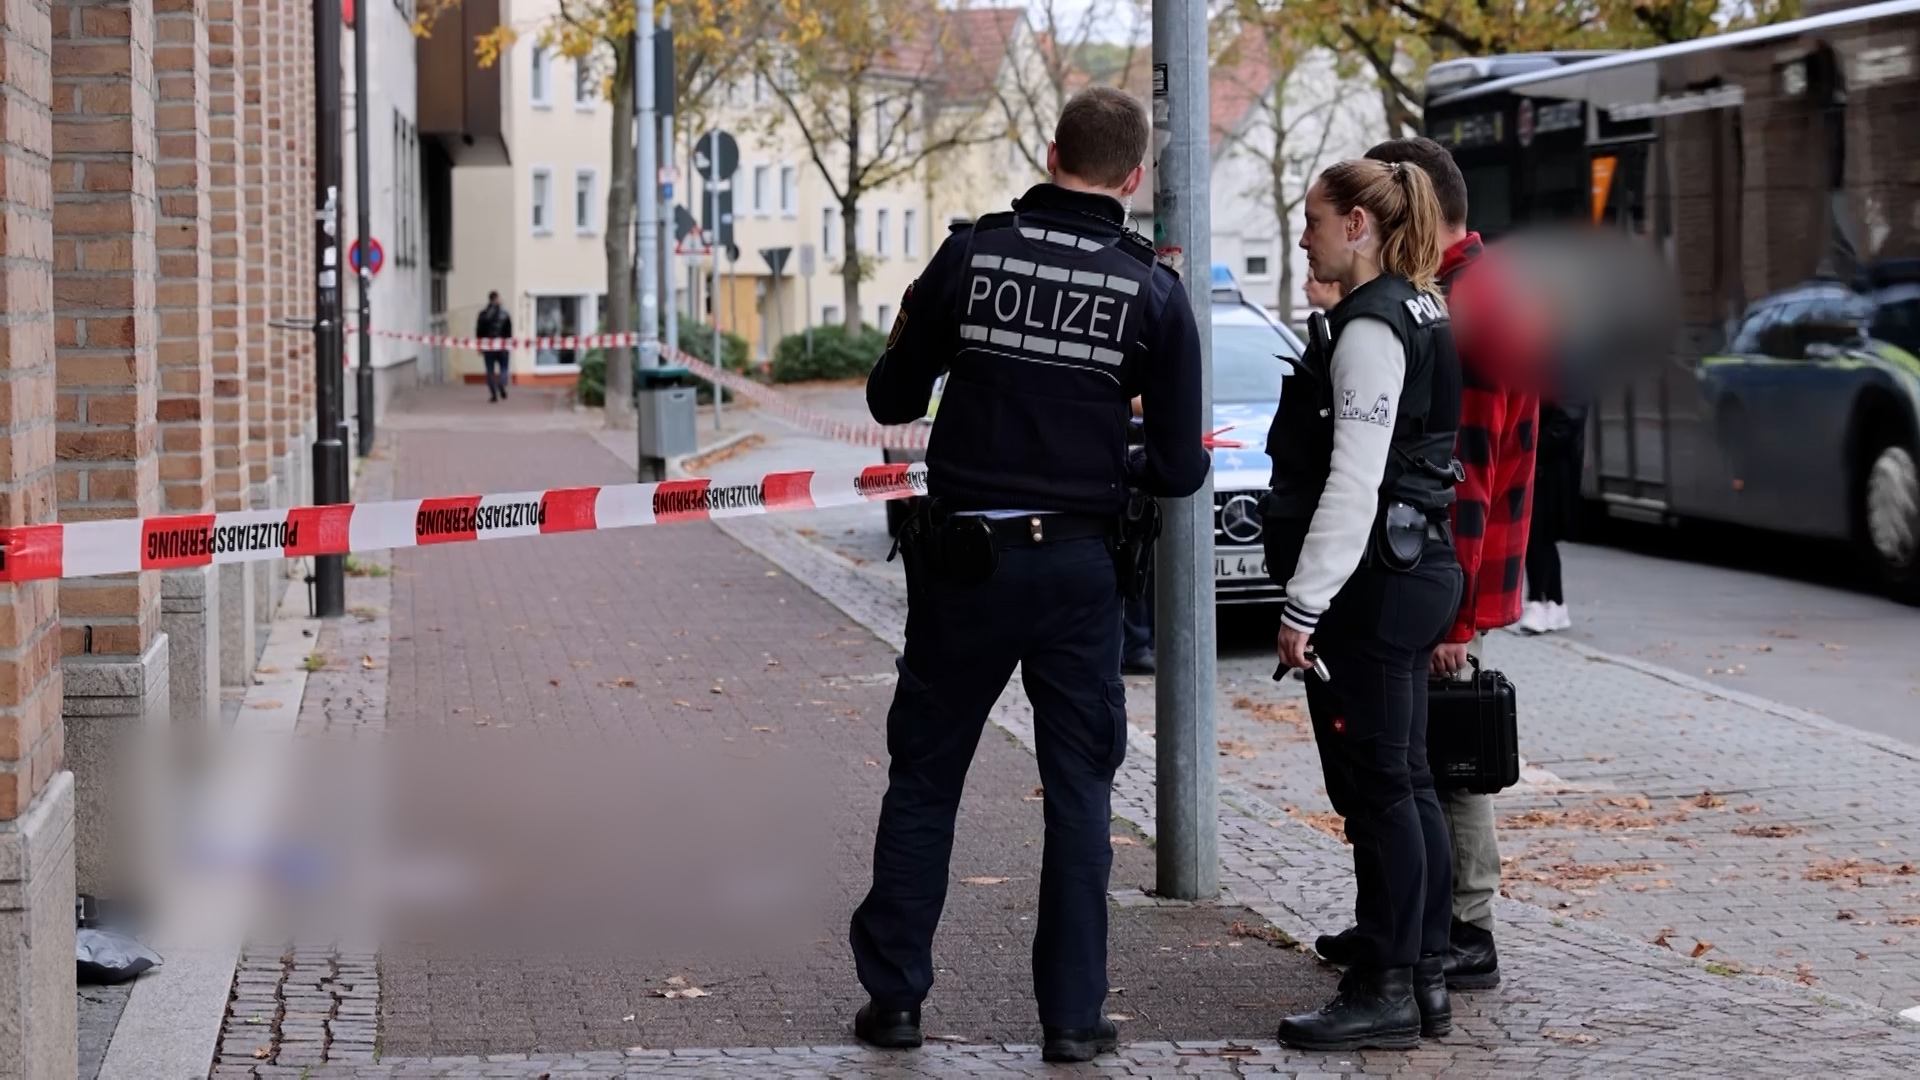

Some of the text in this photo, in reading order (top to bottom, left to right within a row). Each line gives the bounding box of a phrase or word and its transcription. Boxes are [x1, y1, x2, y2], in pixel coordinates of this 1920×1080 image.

[967, 275, 1129, 343] POLIZEI
[1405, 293, 1444, 324] POL
[652, 482, 766, 516] POLIZEIABSPERRUNG
[854, 470, 928, 496] EIABSPERRUNG
[416, 500, 547, 537] POLIZEIABSPERRUNG
[147, 520, 299, 561] POLIZEIABSPERRUNG
[1214, 557, 1231, 576] L
[1237, 557, 1246, 576] 4
